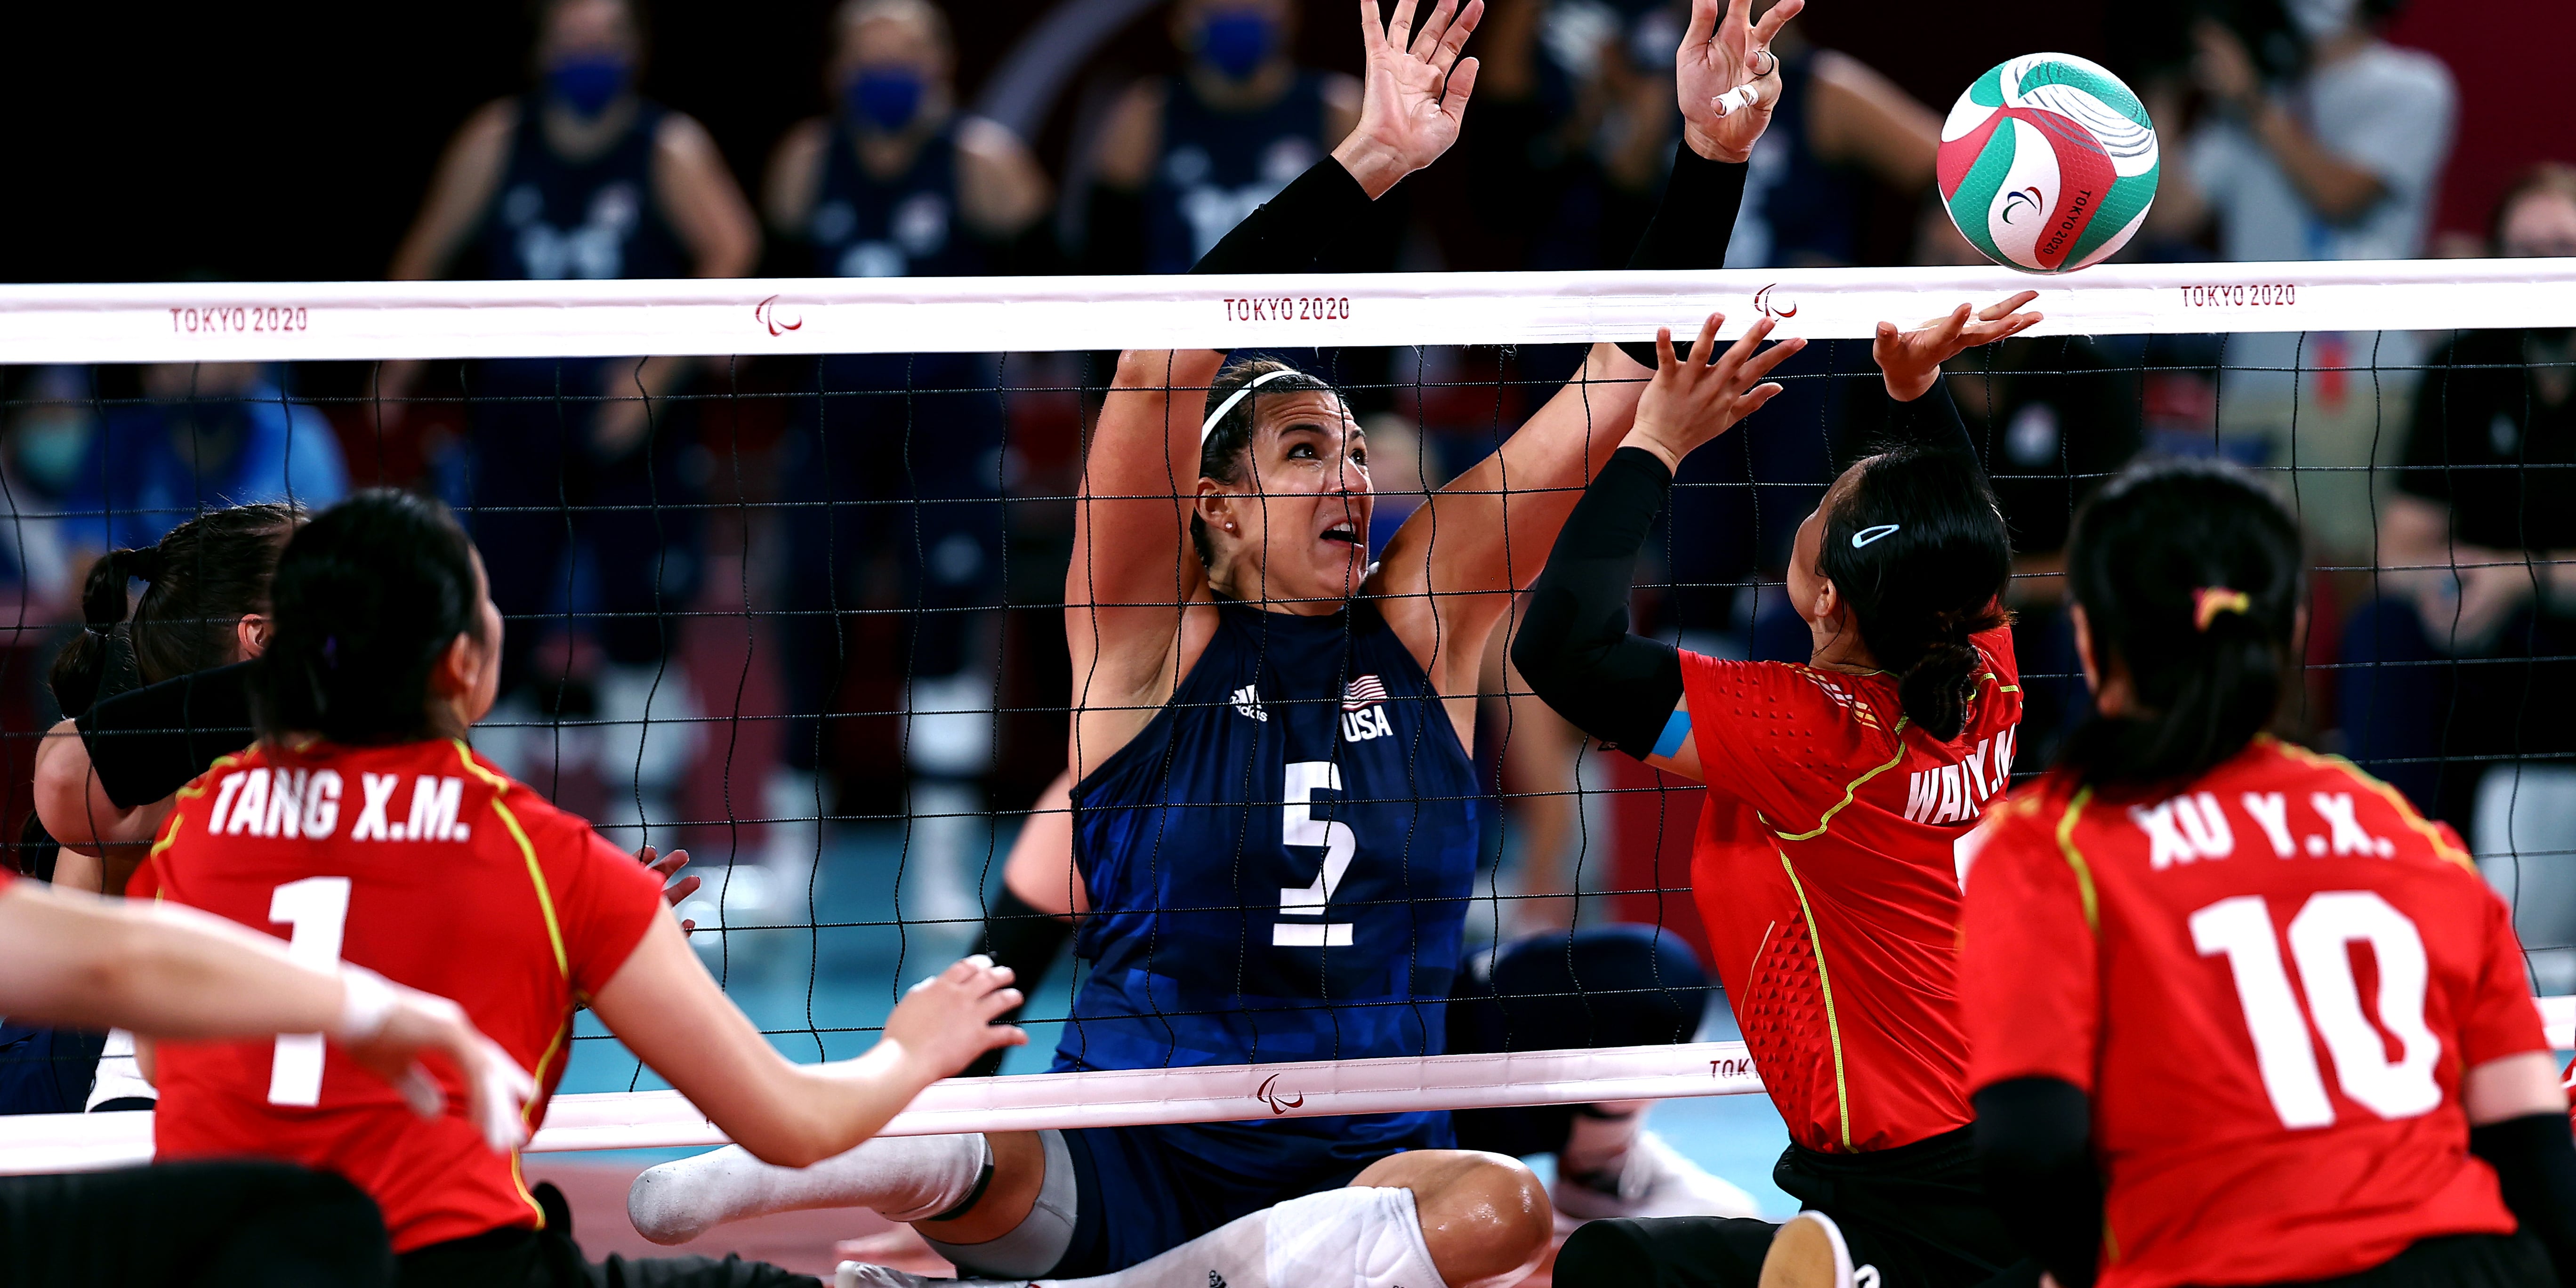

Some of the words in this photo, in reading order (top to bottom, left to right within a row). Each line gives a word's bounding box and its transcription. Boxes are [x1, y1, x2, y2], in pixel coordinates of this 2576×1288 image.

[2064, 190, 2091, 231] TOKYO
[2043, 230, 2068, 255] 2020
[1224, 298, 1293, 321] TOKYO
[1299, 297, 1349, 320] 2020
[2181, 285, 2243, 306] TOKYO
[2250, 284, 2295, 306] 2020
[169, 308, 245, 332] TOKYO
[252, 307, 308, 331] 2020
[1341, 705, 1393, 742] USA
[208, 767, 344, 839] TANG
[351, 771, 471, 842] X.M.
[1280, 761, 1356, 915] 5
[2127, 791, 2235, 870] XU
[2240, 791, 2396, 858] Y.X.
[267, 876, 353, 1107] 1
[2188, 889, 2443, 1131] 10
[1710, 1058, 1759, 1080] TOK
